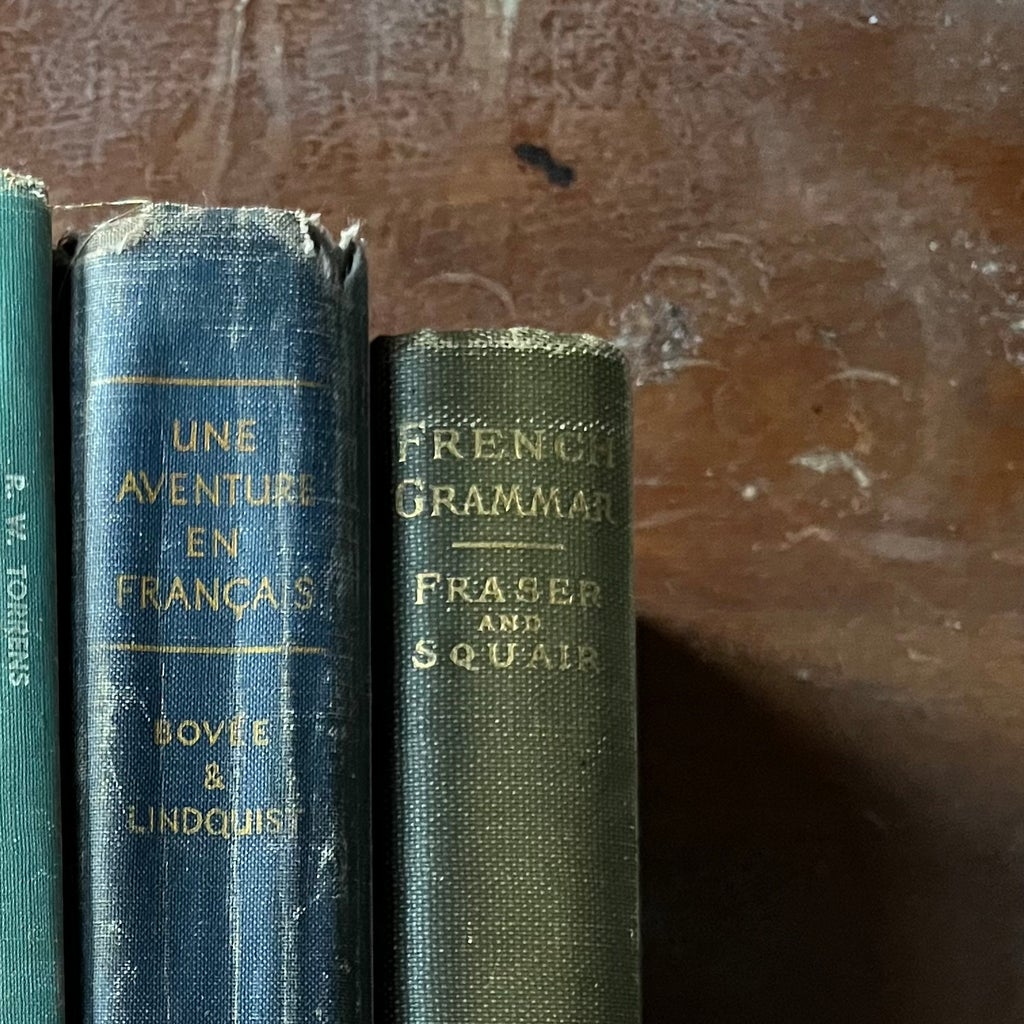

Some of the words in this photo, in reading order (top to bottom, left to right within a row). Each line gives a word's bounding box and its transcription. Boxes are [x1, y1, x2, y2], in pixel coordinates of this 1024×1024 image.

[172, 418, 257, 453] UNE
[397, 421, 616, 469] FRENCH
[114, 470, 317, 508] AVENTURE
[394, 478, 617, 526] GRAMMAR
[186, 525, 240, 559] EN
[414, 572, 602, 608] FRASER
[6, 564, 30, 688] TORRENS
[478, 613, 542, 633] AND
[410, 639, 602, 674] SQUAIR
[203, 760, 226, 791] &
[127, 803, 303, 840] LINDQUIST
